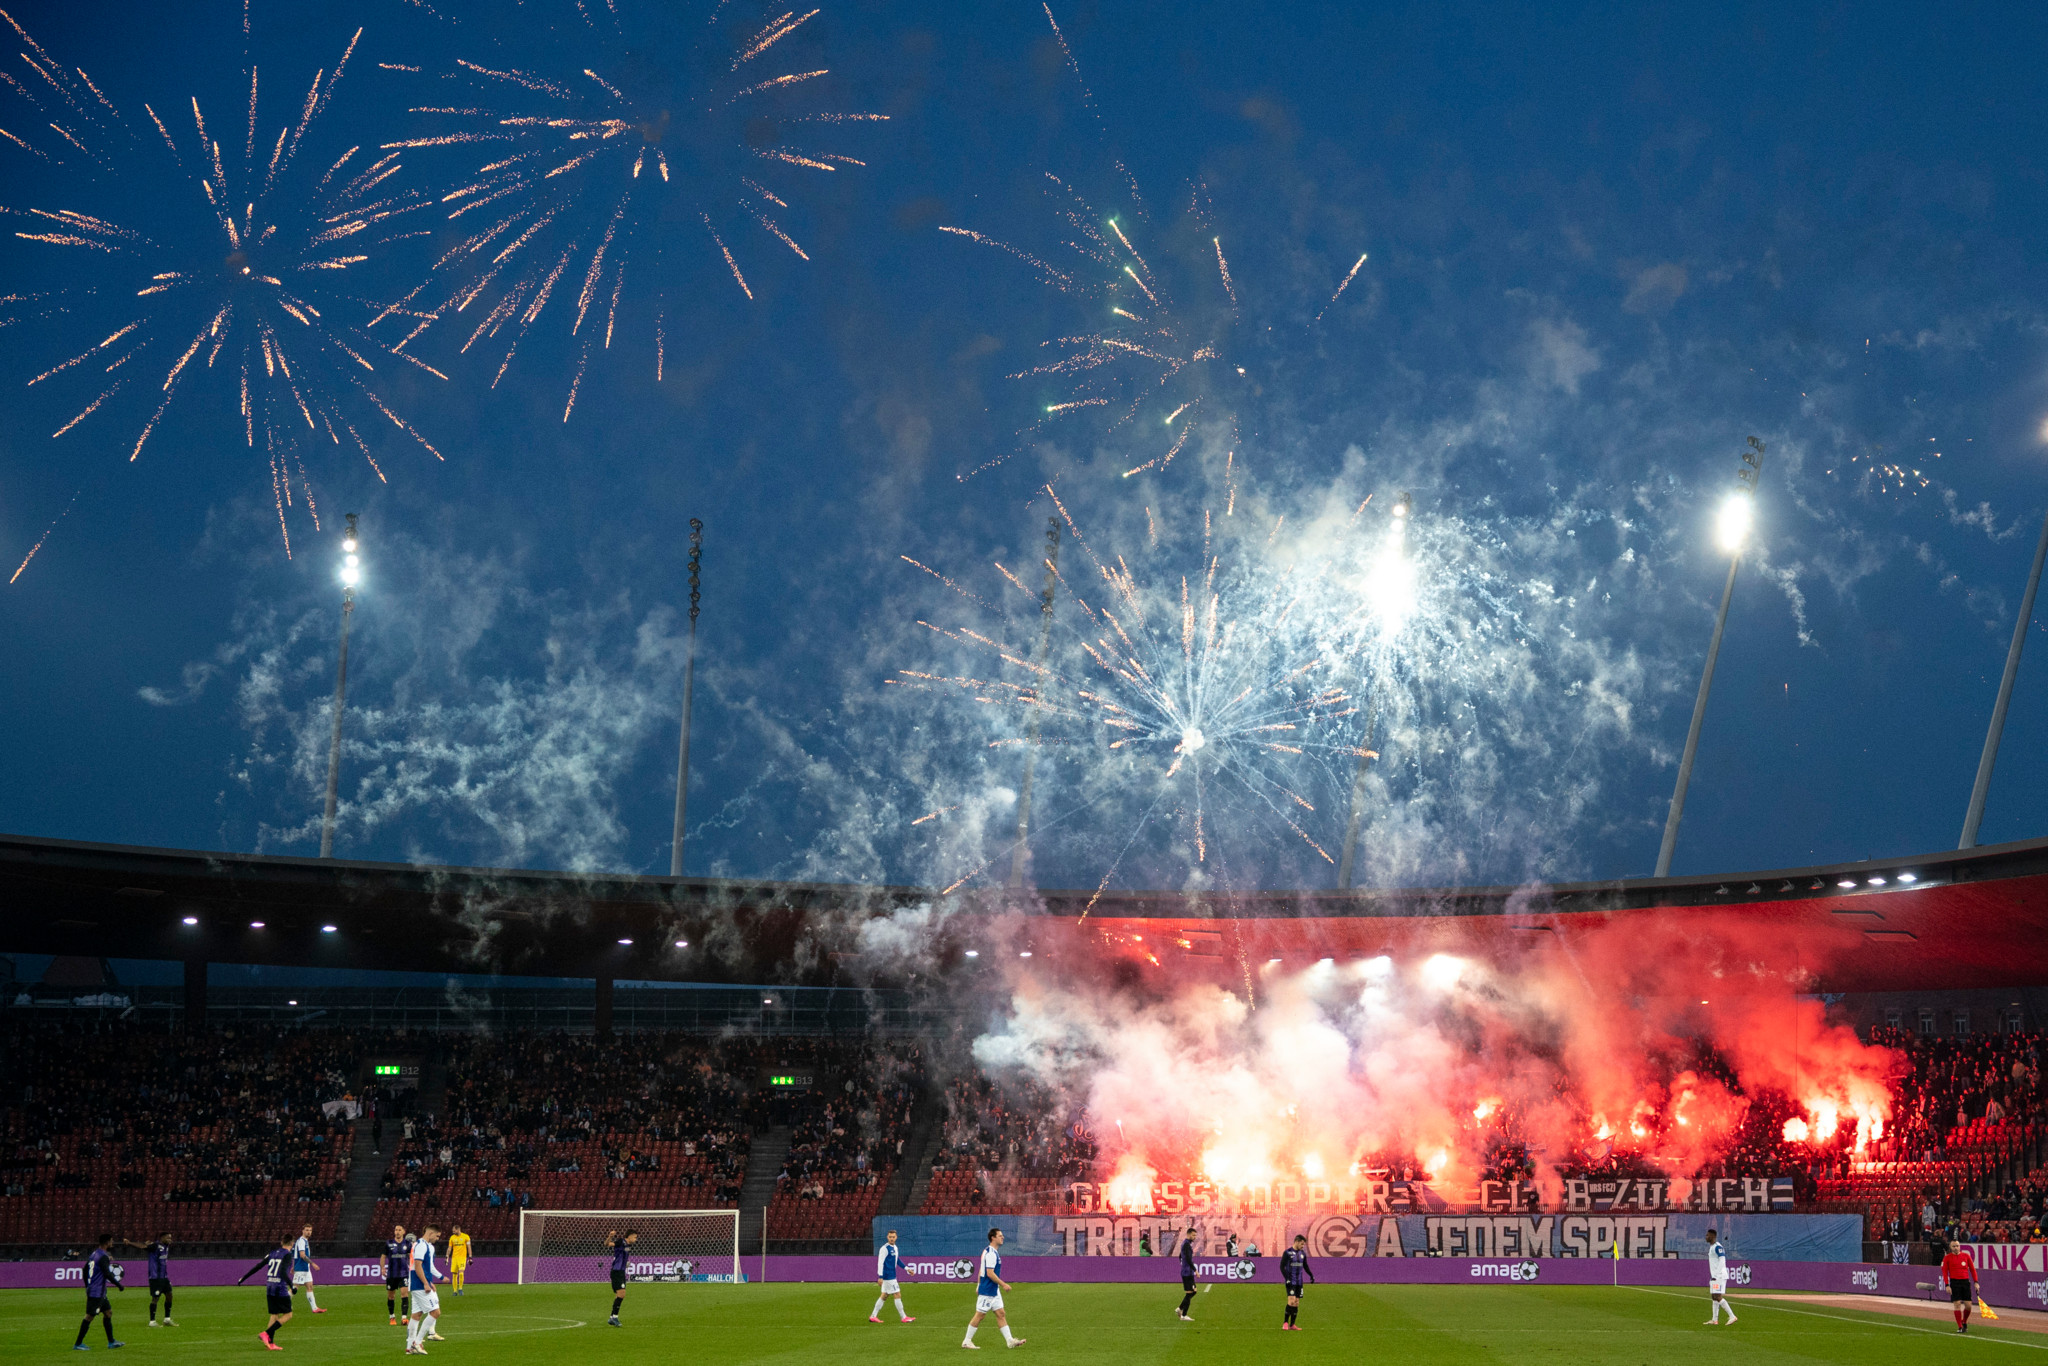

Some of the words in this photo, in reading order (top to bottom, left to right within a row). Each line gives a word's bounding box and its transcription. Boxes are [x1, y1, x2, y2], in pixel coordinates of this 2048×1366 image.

[401, 1066, 419, 1075] B12
[796, 1076, 813, 1085] B13
[1414, 1217, 1554, 1258] JEDEM
[1562, 1217, 1679, 1258] SPIEL
[267, 1259, 282, 1276] 27
[906, 1261, 957, 1279] amag
[1470, 1262, 1521, 1280] amag
[1852, 1269, 1872, 1290] amag
